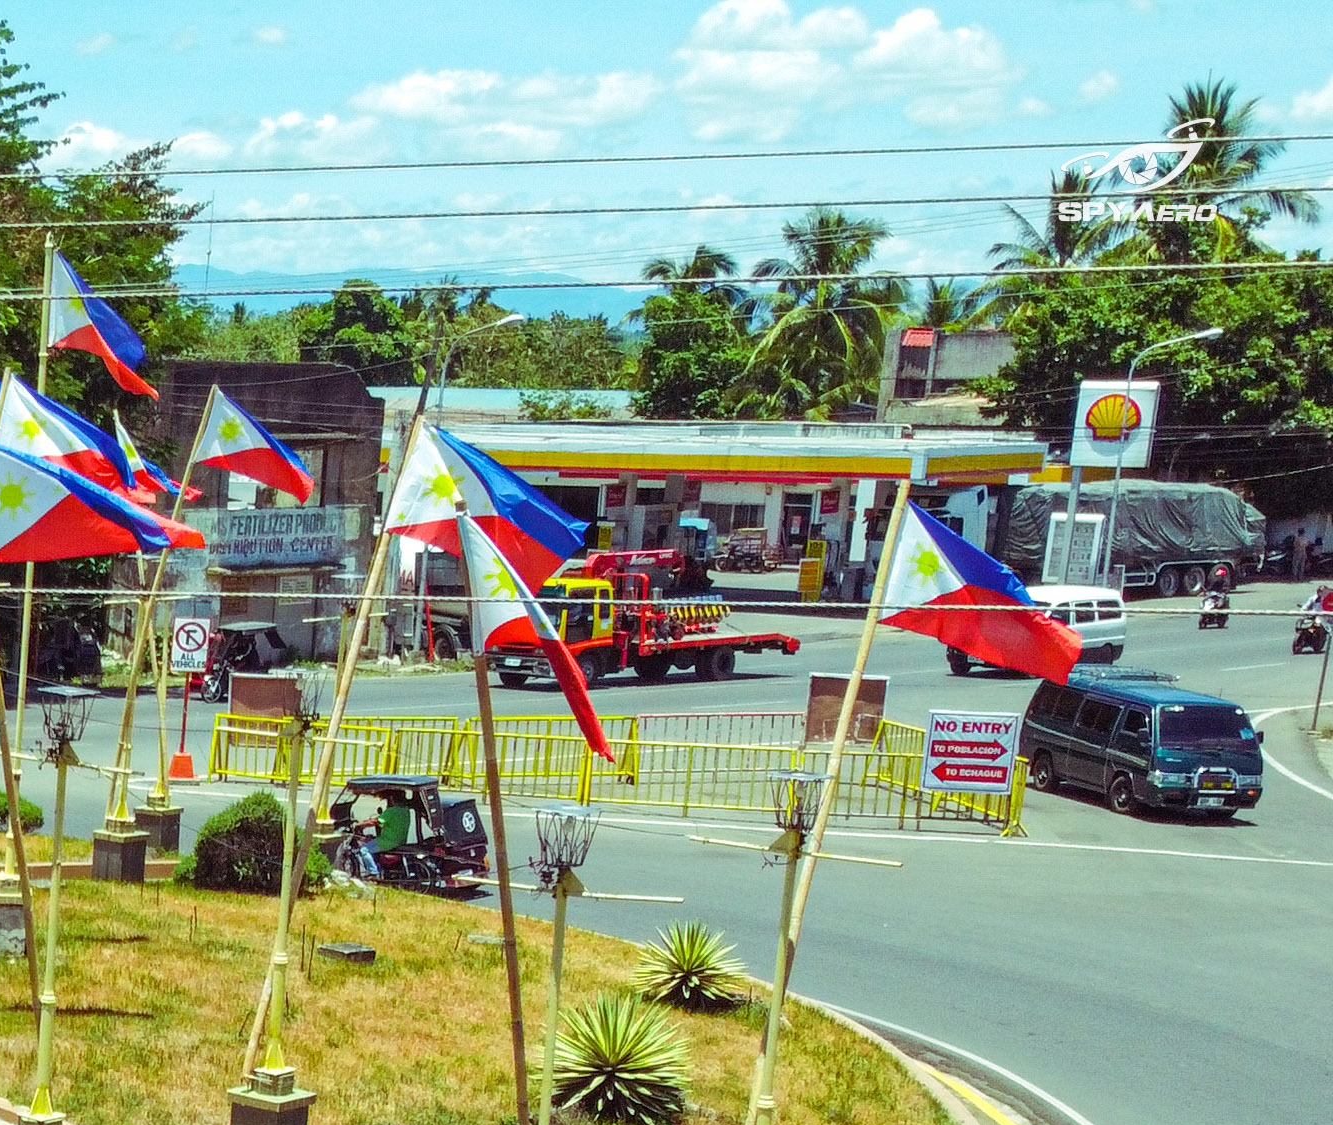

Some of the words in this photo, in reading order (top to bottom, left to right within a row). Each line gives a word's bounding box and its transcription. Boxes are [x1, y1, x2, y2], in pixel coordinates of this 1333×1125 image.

[290, 535, 333, 553] CENTER
[180, 653, 195, 661] ALL
[171, 660, 206, 669] VEHICLES
[934, 720, 958, 732] NO
[962, 721, 1013, 734] ENTRY
[947, 745, 1002, 755] POBLACION
[945, 768, 958, 776] TO
[959, 768, 1004, 778] ECHAGUE
